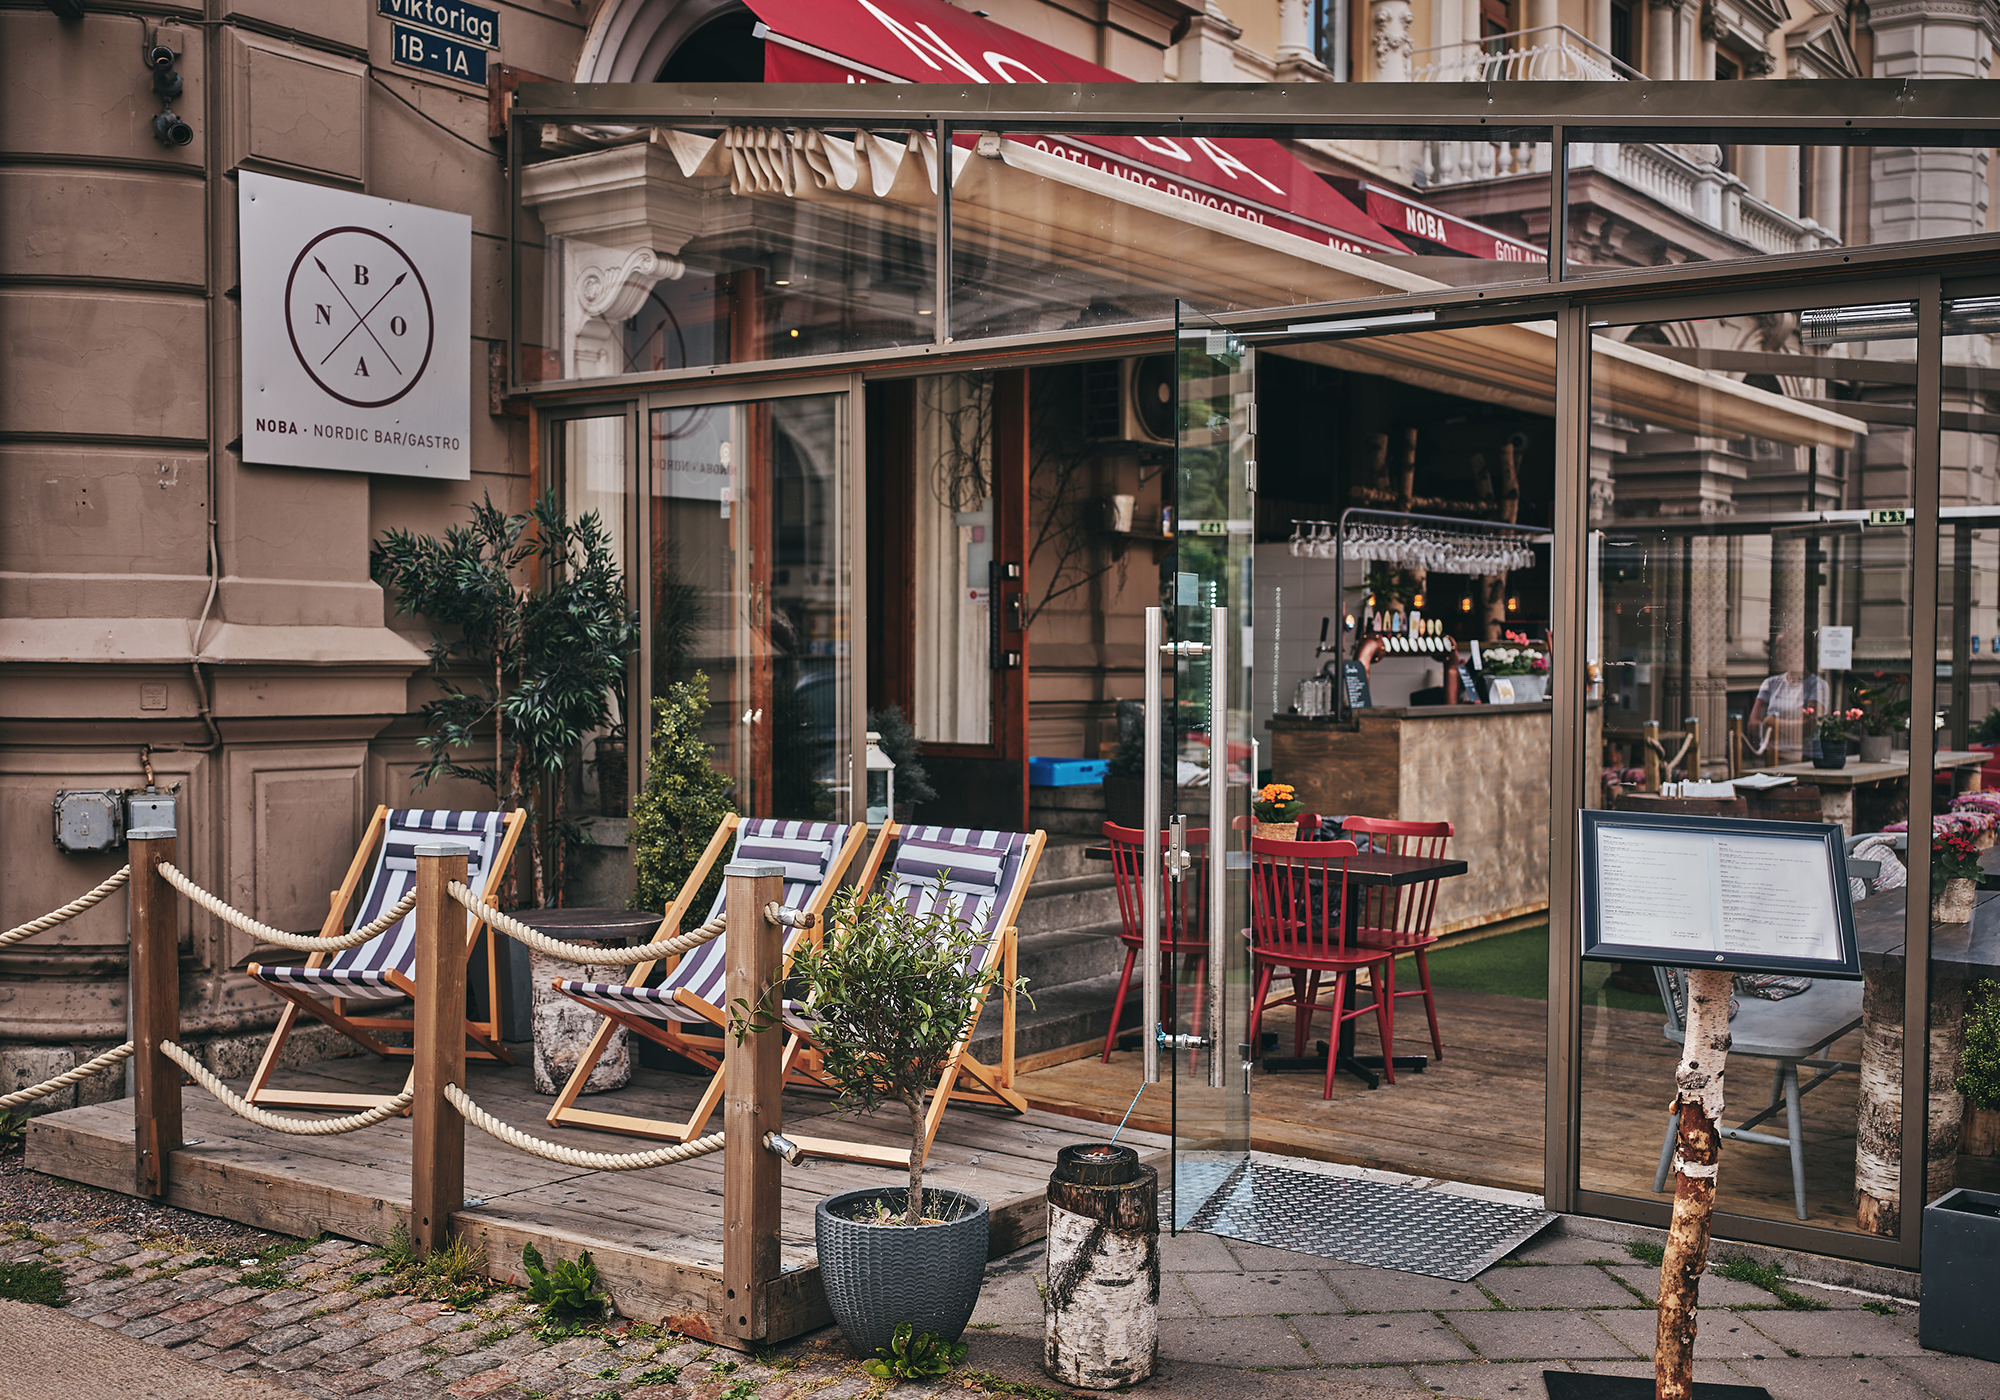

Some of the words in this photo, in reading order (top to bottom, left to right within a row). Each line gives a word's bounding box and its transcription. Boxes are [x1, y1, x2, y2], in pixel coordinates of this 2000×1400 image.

[401, 34, 425, 62] 1B
[445, 46, 470, 76] 1A
[1405, 206, 1447, 243] NOBA
[353, 264, 370, 286] B
[314, 303, 332, 326] N
[390, 315, 408, 337] O
[354, 355, 371, 378] A
[256, 417, 298, 436] NOBA
[313, 423, 369, 442] NORDIC
[374, 430, 460, 451] BAR/GASTRO
